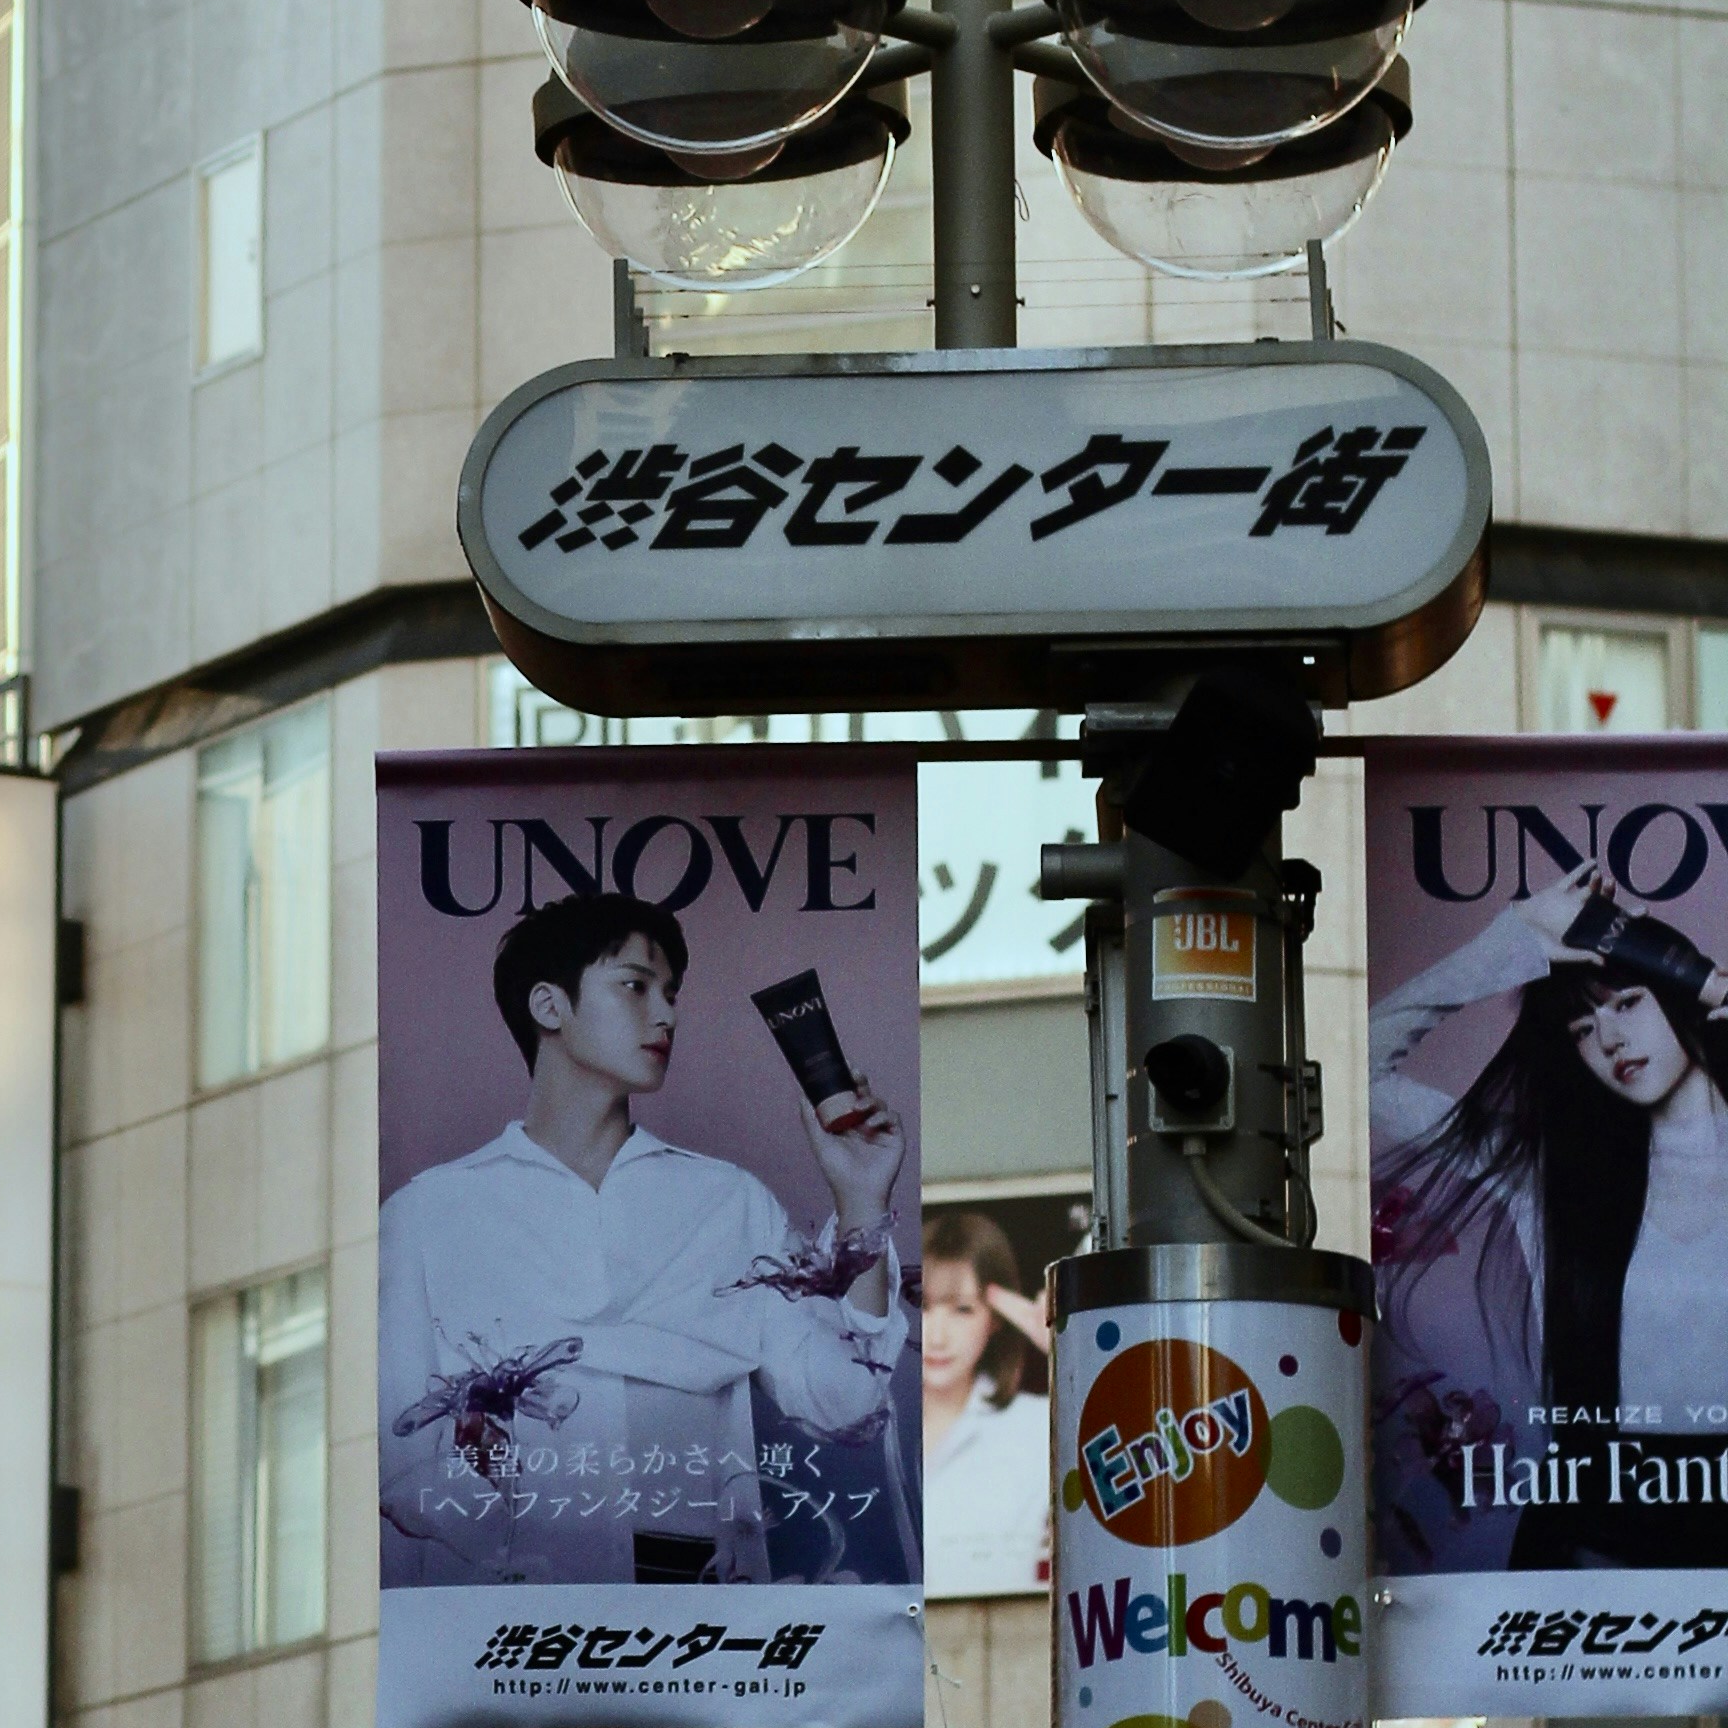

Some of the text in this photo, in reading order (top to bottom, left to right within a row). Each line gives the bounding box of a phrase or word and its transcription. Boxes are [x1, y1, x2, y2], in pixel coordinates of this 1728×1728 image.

[518, 425, 1428, 552] 渋谷センター街
[413, 813, 876, 917] UNOVE
[1173, 912, 1240, 954] JBL
[1528, 1405, 1663, 1425] REALIZE
[446, 1442, 823, 1478] 羨望の柔らかさへ導く
[1082, 1387, 1255, 1522] Enjoy
[1459, 1442, 1591, 1507] Hair
[475, 1623, 826, 1671] 渋谷センター街
[1068, 1574, 1362, 1670] Welcome
[493, 1677, 808, 1697] http://www.center-gai.jp
[1215, 1651, 1283, 1719] Shibuya
